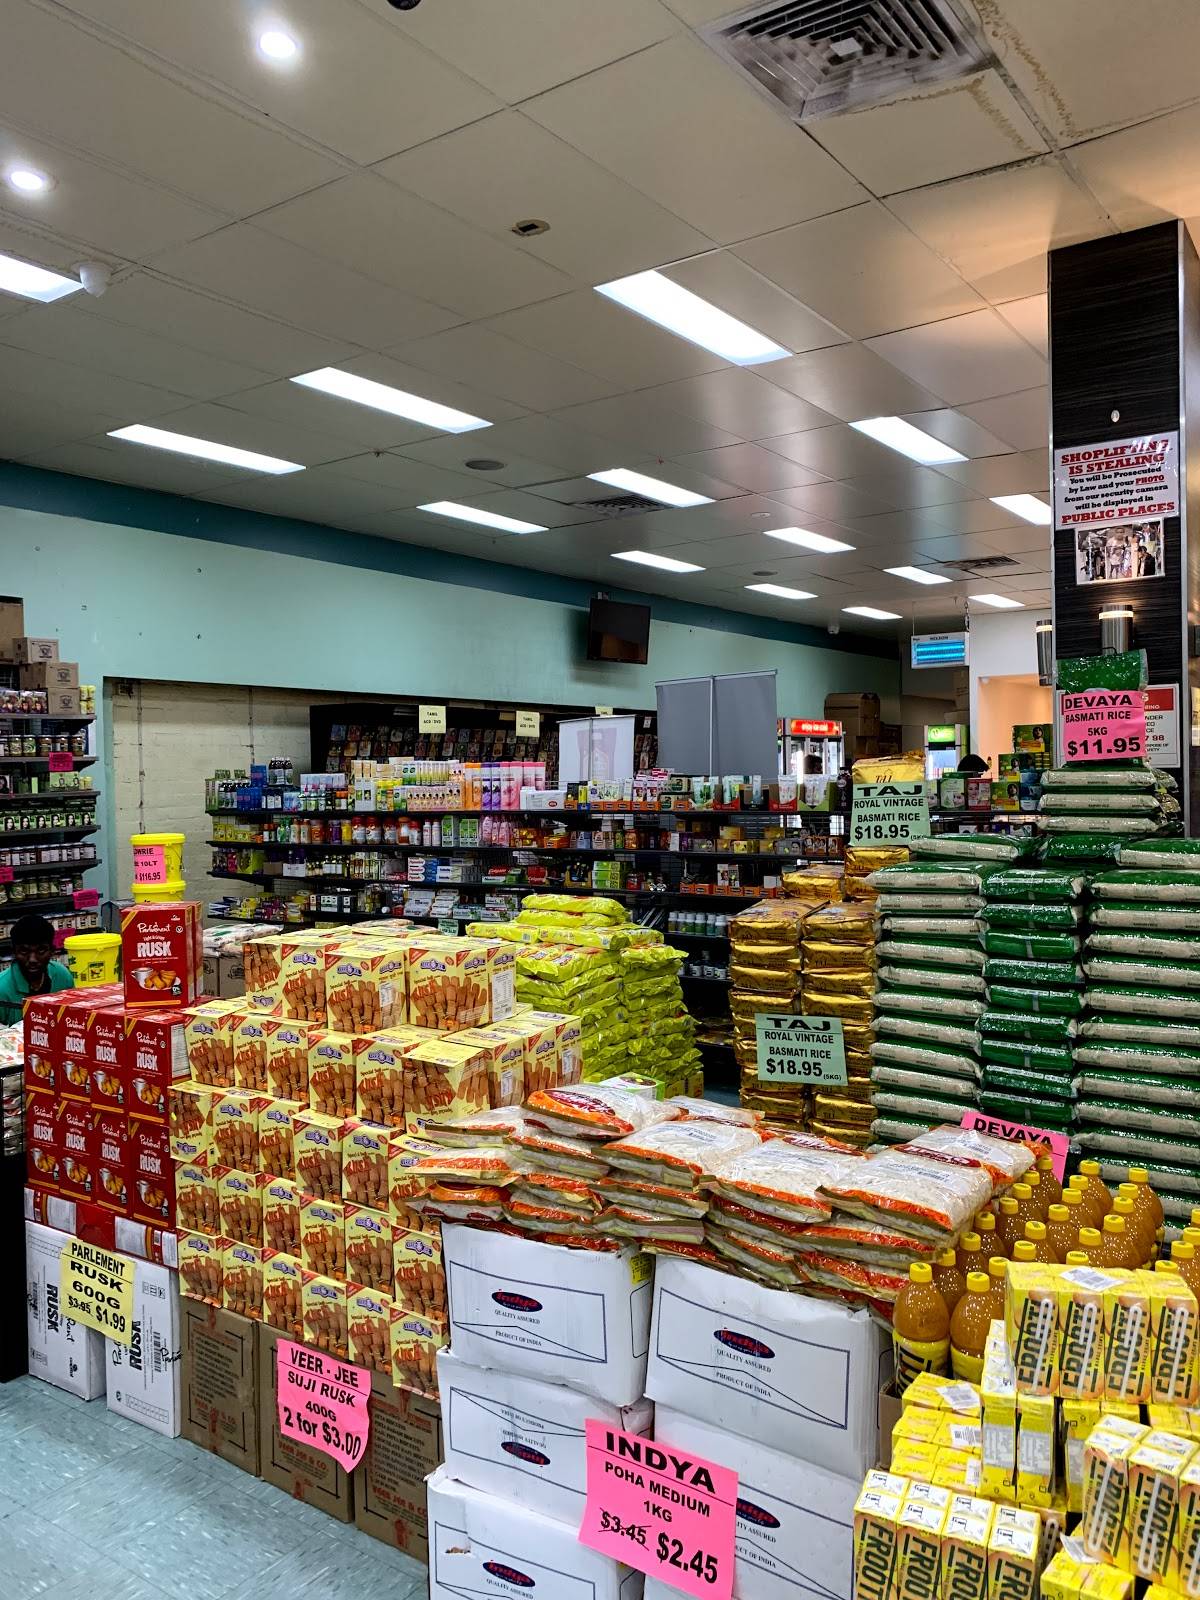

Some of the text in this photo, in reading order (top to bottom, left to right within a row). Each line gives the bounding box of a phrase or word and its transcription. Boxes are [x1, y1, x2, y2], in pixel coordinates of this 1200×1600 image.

[1061, 440, 1169, 464] SHOPLIFTING
[1069, 453, 1165, 475] IS STEALING
[1068, 486, 1078, 495] by
[1080, 483, 1097, 492] Law
[1115, 480, 1135, 489] your
[1136, 474, 1165, 485] PHOTO
[1070, 466, 1162, 485] You will be Prosecuted
[1064, 495, 1084, 503] from
[1101, 488, 1134, 499] security
[1136, 484, 1168, 493] camera
[1075, 502, 1090, 510] will
[1103, 496, 1143, 508] displayed
[1062, 502, 1175, 523] PUBLIC PLACES
[1065, 695, 1132, 709] DEVAYA
[1066, 711, 1131, 723] BASMATI RICE
[1088, 727, 1108, 736] 5KG
[1068, 737, 1141, 757] $11.95
[857, 785, 922, 797] TAJ
[854, 799, 924, 809] ROYAL VINTAGE
[858, 813, 920, 822] BASMATI RICE
[855, 825, 910, 841] $18.95
[137, 942, 172, 958] RUSK
[767, 1018, 831, 1031] TAJ
[30, 1030, 49, 1048] RUSK
[66, 1036, 86, 1054] RUSK
[765, 1031, 834, 1044] ROYAL VINTAGE
[96, 1045, 117, 1063] RUSK
[136, 1052, 158, 1071] RUSK
[770, 1046, 831, 1059] BASMATI RICE
[766, 1058, 822, 1077] $18.95
[34, 1124, 53, 1142] RUSK
[974, 1118, 1052, 1145] DEVAYA
[66, 1133, 86, 1151] RUSK
[102, 1142, 121, 1162] RUSK
[140, 1154, 161, 1175] RUSK
[72, 1242, 125, 1277] PARLEMENT
[70, 1261, 124, 1293] RUSK
[72, 1281, 121, 1310] 600G
[47, 1284, 59, 1333] RUSK
[68, 1296, 91, 1314] $3.95
[96, 1308, 126, 1333] $1.99
[495, 1309, 541, 1325] QUALITY ASSURED
[496, 1330, 518, 1341] PRODUCT
[130, 1320, 142, 1371] RUSK
[291, 1348, 323, 1375] VEER
[335, 1366, 359, 1388] JEE
[717, 1349, 743, 1362] QUALITY
[744, 1360, 772, 1373] ASSURED
[288, 1371, 356, 1407] SUJI RUSK
[716, 1372, 743, 1387] PRODUCT
[754, 1386, 771, 1397] INDIA
[306, 1401, 337, 1422] 400G
[284, 1406, 361, 1460] 2 for $3.00
[606, 1432, 715, 1494] INDYA
[605, 1462, 645, 1488] POHA
[650, 1480, 710, 1517] MEDIUM
[644, 1501, 673, 1523] 1KG
[748, 1528, 777, 1543] ASSURED
[600, 1511, 718, 1584] $3.45 $2.45
[758, 1556, 776, 1568] INDIA
[486, 1578, 509, 1590] QUALITY
